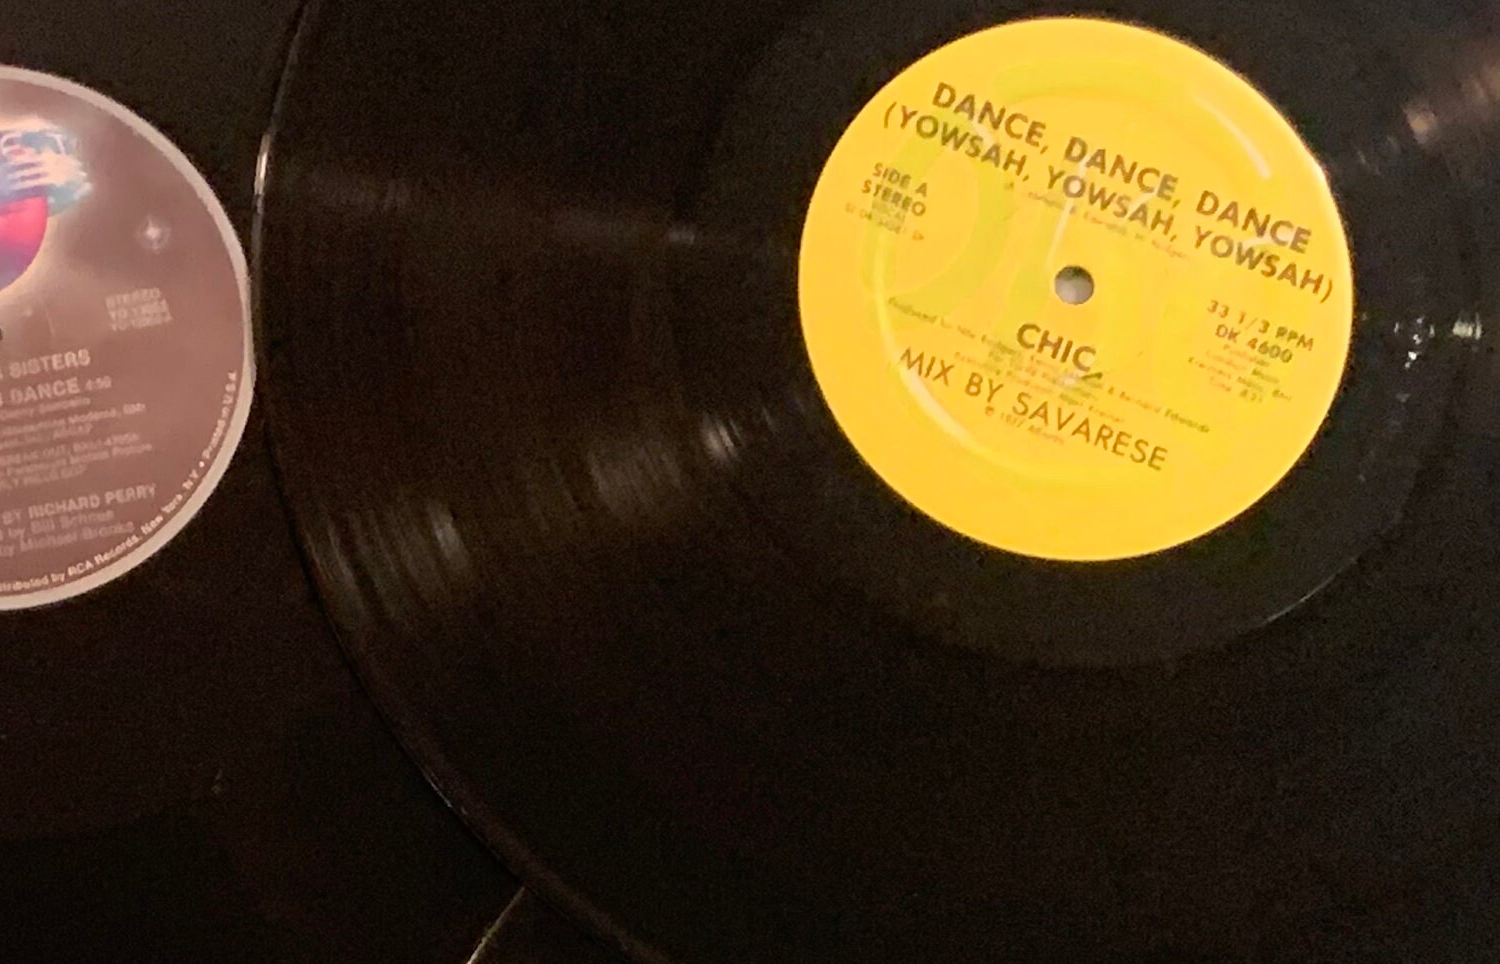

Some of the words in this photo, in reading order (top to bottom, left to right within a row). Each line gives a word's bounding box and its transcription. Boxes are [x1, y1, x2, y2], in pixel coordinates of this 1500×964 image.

[873, 162, 912, 189] SIDE
[915, 182, 928, 198] A
[932, 82, 1048, 155] DANCE,
[1064, 136, 1181, 208] DANCE,
[1196, 190, 1312, 254] DANCE
[861, 179, 927, 217] STEREO
[883, 101, 1030, 182] (YOWSAH,
[1047, 165, 1178, 242] YOWSAH,
[1195, 225, 1334, 304] YOWSAH)
[1017, 323, 1097, 373] CHIC
[1275, 325, 1314, 351] RPM
[9, 349, 91, 379] SISTERS
[10, 377, 80, 402] DANCE
[900, 346, 955, 388] MIX
[964, 371, 1003, 403] BY
[1012, 391, 1169, 472] SAVARESE
[3, 509, 22, 525] BY
[28, 495, 101, 519] RICHARD
[105, 483, 156, 504] PERRY
[68, 558, 94, 577] RCA
